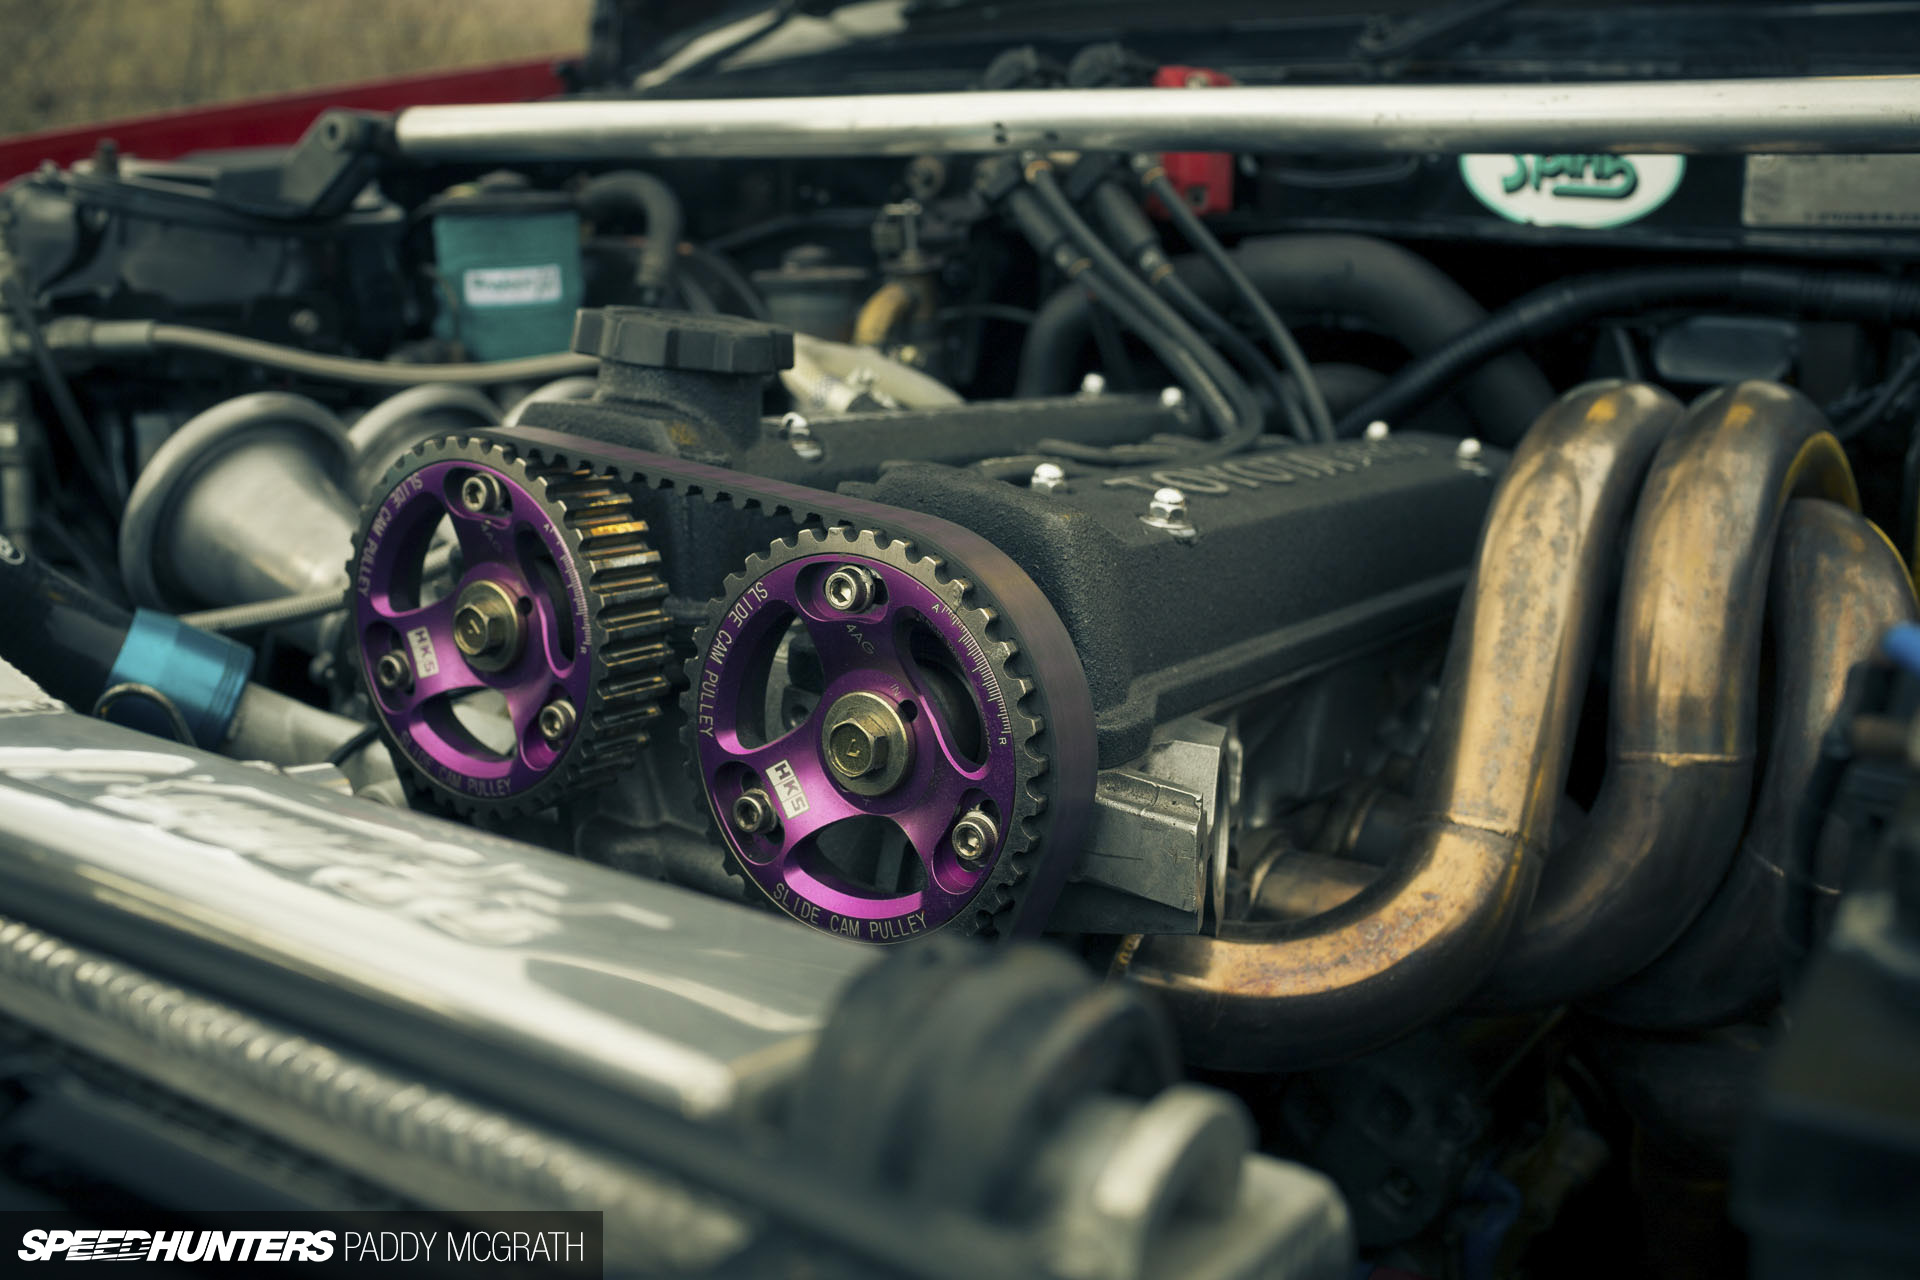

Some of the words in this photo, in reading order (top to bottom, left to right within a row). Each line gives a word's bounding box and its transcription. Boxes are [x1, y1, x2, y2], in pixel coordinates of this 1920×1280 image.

[391, 472, 423, 508] SLIDE
[371, 506, 392, 537] CAM
[358, 538, 378, 597] PULLEY
[728, 581, 768, 628] SLIDE
[932, 603, 940, 614] A
[411, 627, 437, 677] HKS
[710, 629, 733, 665] CAM
[846, 624, 875, 655] 4AG
[699, 669, 719, 737] PULLEY
[998, 736, 1007, 745] R
[468, 778, 511, 796] PULLEY
[769, 761, 808, 817] HKS
[773, 882, 821, 925] SLIDE
[830, 914, 860, 937] CAM
[869, 911, 927, 939] PULLEY
